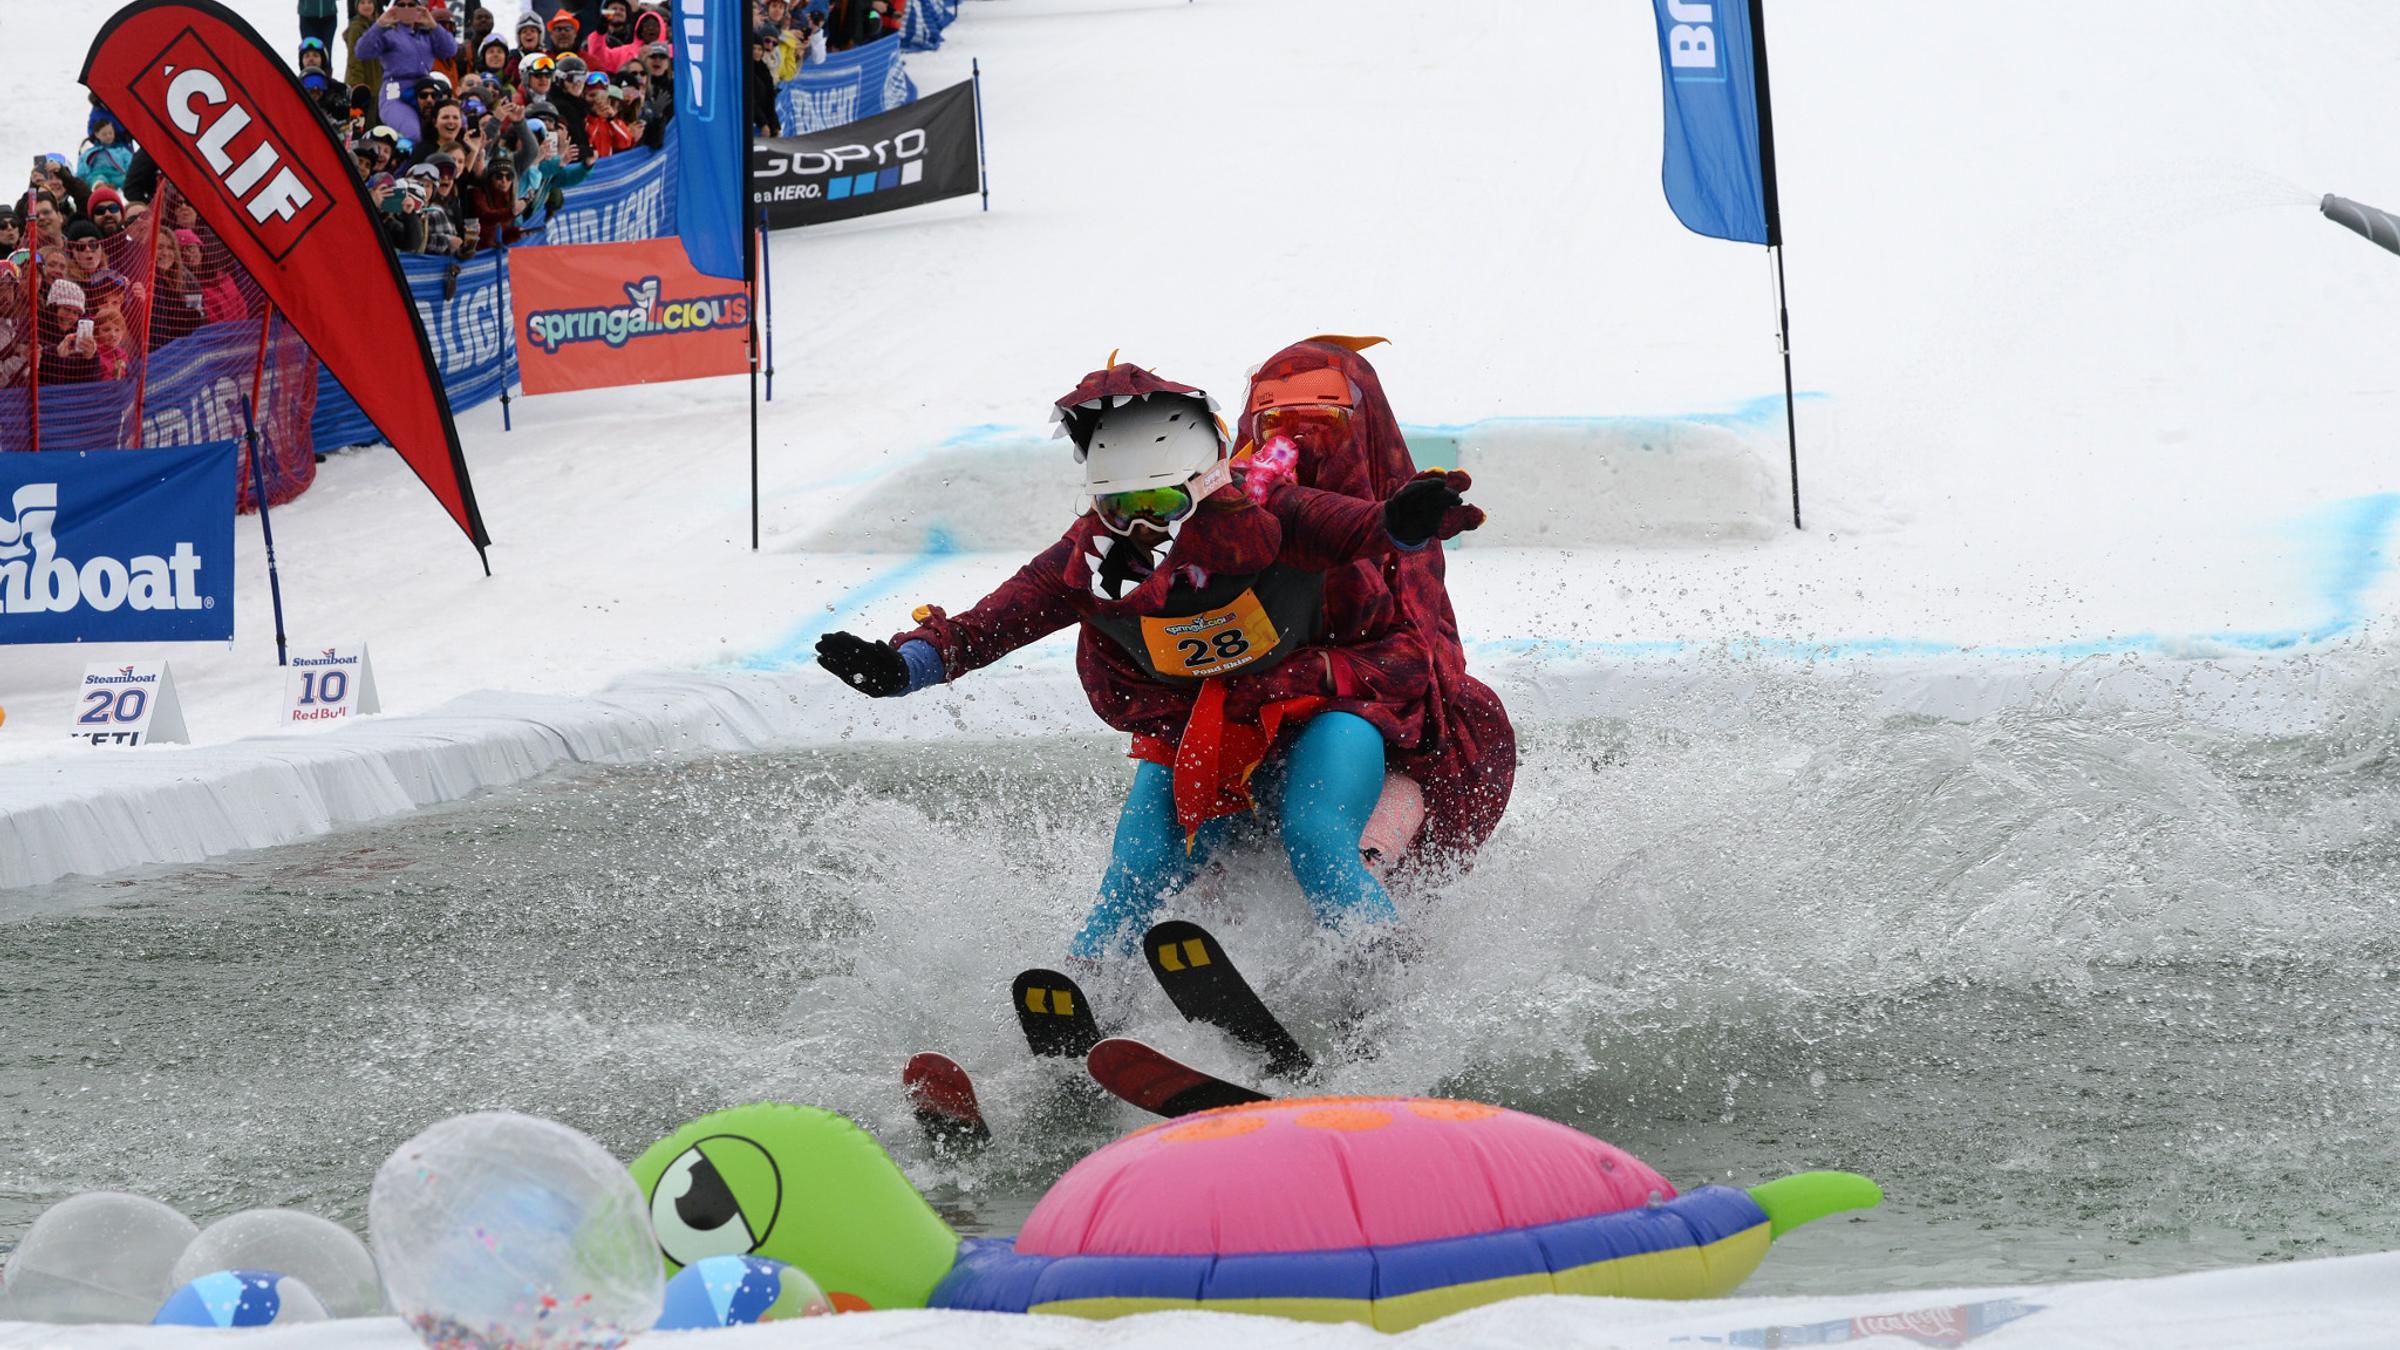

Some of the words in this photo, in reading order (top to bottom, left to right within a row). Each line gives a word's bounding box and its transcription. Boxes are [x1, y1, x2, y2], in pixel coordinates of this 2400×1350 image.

[166, 68, 314, 225] CLIF
[529, 280, 747, 350] springalicious
[292, 648, 358, 667] Steamboat
[1177, 629, 1250, 668] 28
[85, 667, 156, 684] Steamboat
[1192, 665, 1221, 676] Pond
[1222, 655, 1253, 671] Skim
[299, 670, 348, 705] 10
[78, 688, 147, 724] 20
[292, 709, 318, 721] Red
[320, 706, 346, 719] Bull
[71, 731, 139, 747] ETI
